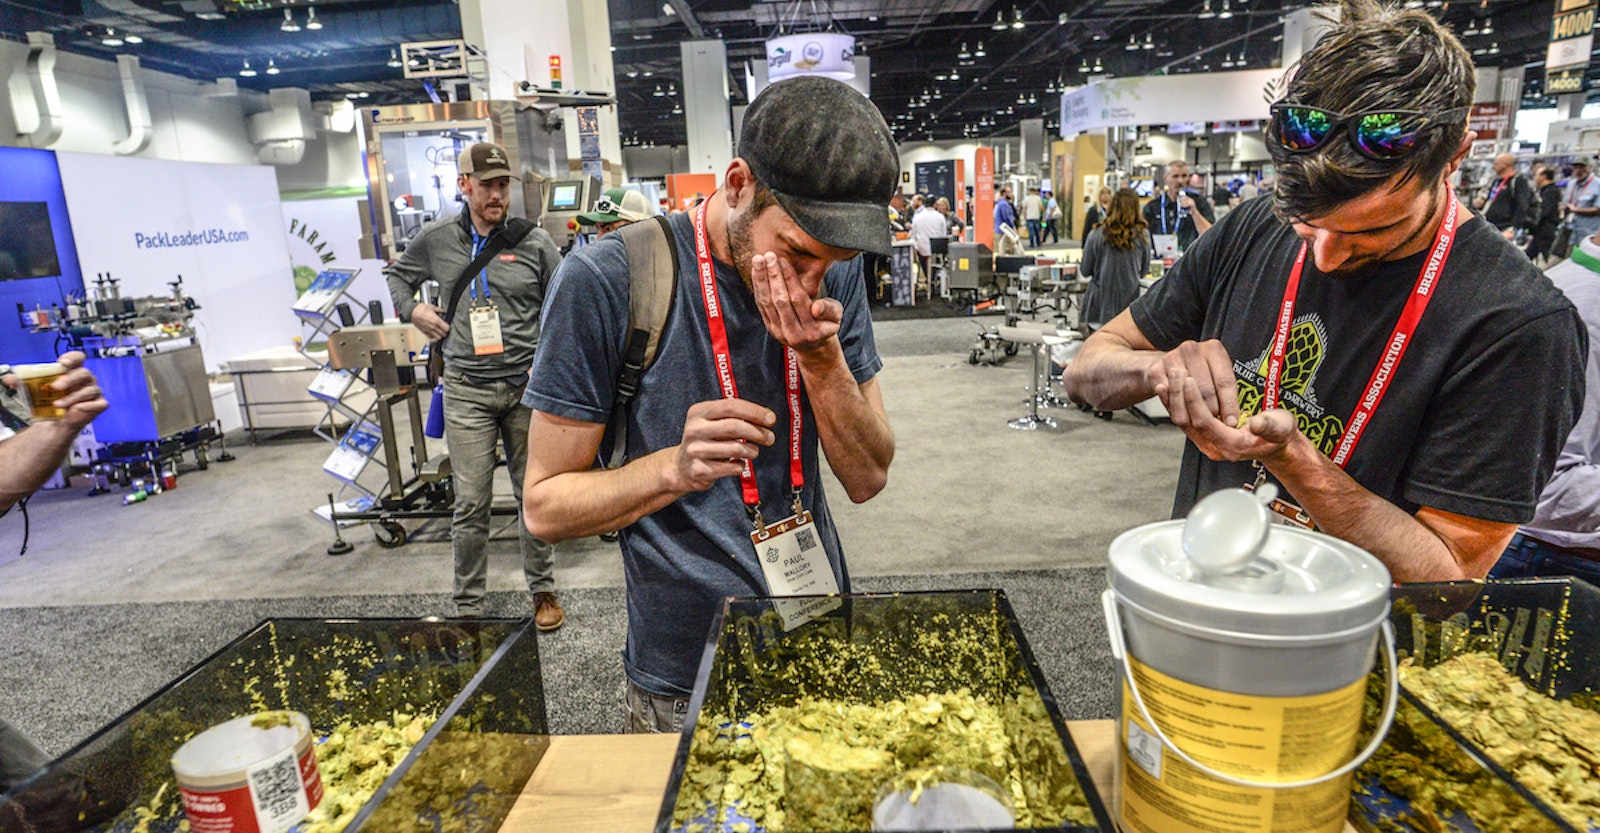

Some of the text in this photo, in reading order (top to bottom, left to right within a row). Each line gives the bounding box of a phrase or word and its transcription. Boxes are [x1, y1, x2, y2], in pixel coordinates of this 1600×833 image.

[1553, 10, 1594, 40] 14000
[1549, 77, 1581, 90] 14000
[135, 229, 249, 249] PackLeaderUSA.com
[289, 218, 337, 265] FARAM
[1416, 234, 1451, 297] BREWERS
[701, 261, 719, 319] BREWERS
[1273, 300, 1293, 357] BREWERS
[717, 353, 736, 400] CIATION
[1333, 331, 1407, 465] BREWERS ASSOCIATION
[790, 393, 801, 460] ASSOCIATION
[783, 555, 805, 567] PAUL
[783, 563, 810, 577] MALLORY
[789, 598, 832, 620] CONFERENCE
[270, 799, 296, 818] 3B8
